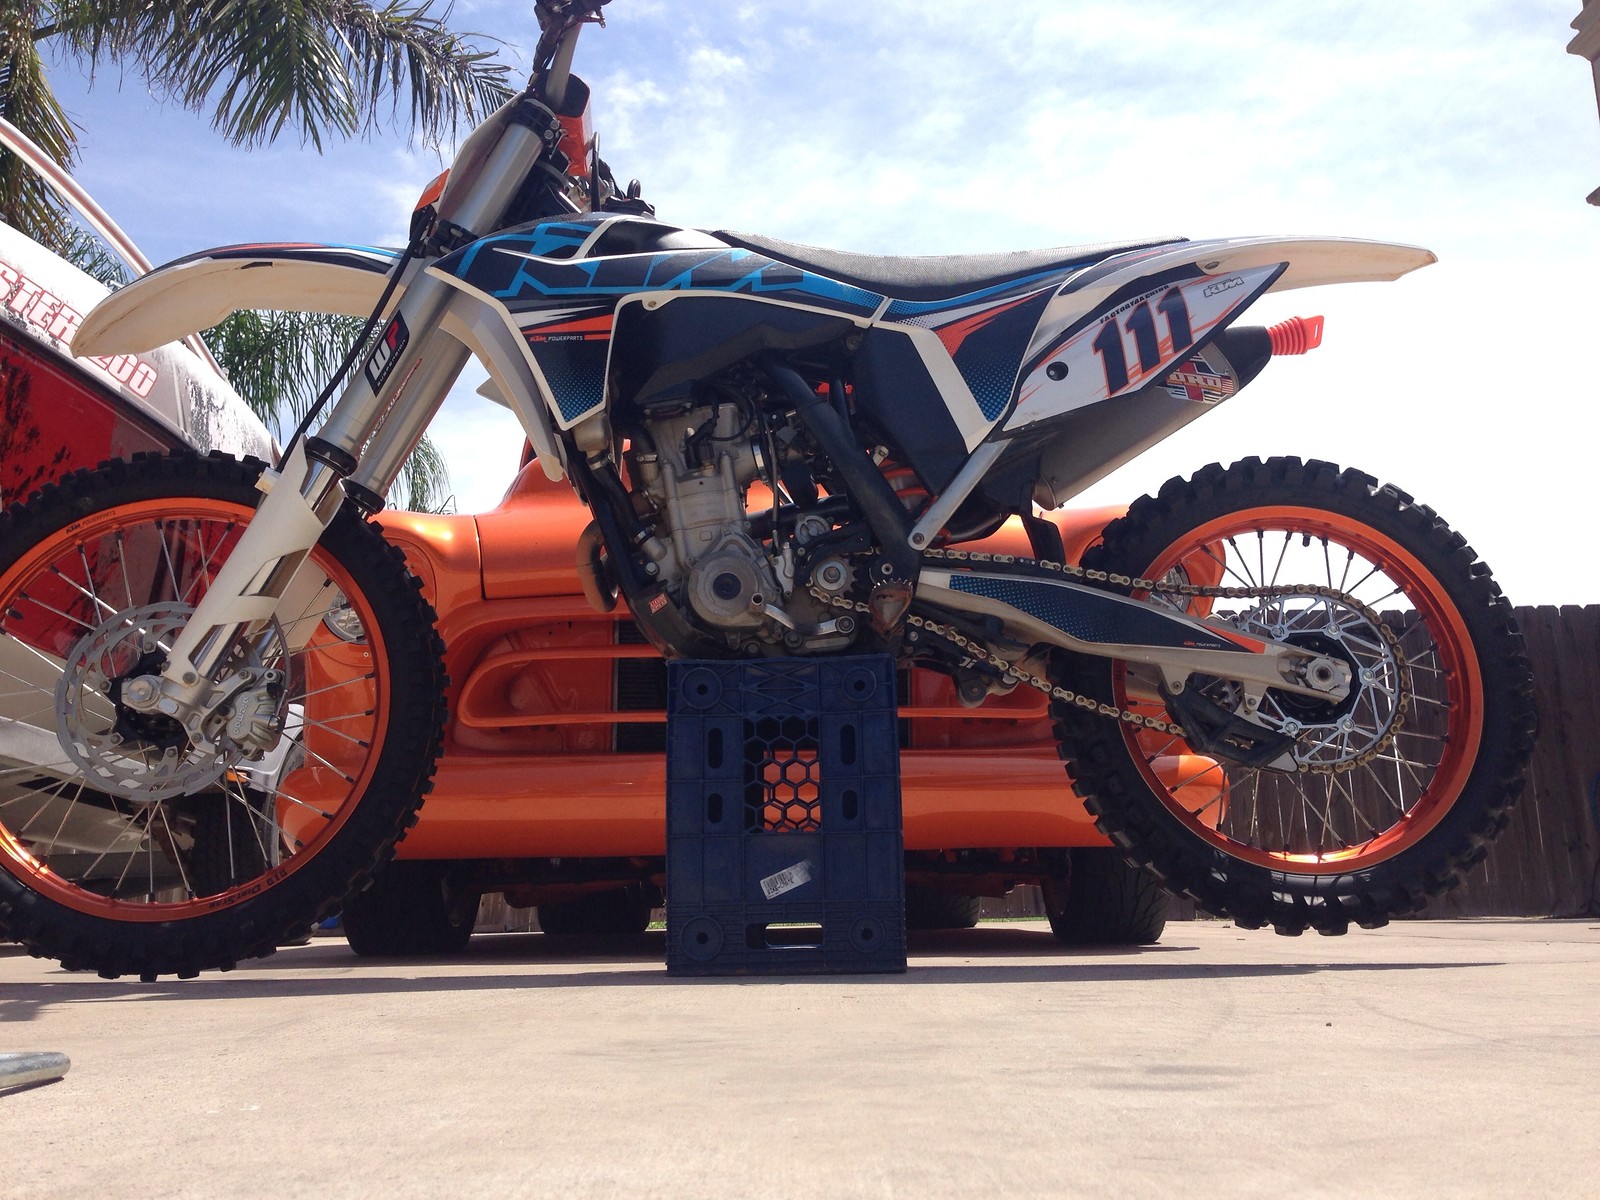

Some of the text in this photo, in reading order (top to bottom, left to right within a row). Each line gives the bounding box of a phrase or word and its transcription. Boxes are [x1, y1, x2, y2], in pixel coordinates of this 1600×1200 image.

[1203, 276, 1244, 298] KTM
[369, 320, 399, 381] WP
[1092, 286, 1194, 397] 111
[86, 354, 158, 398] 00
[233, 697, 252, 733] brembo
